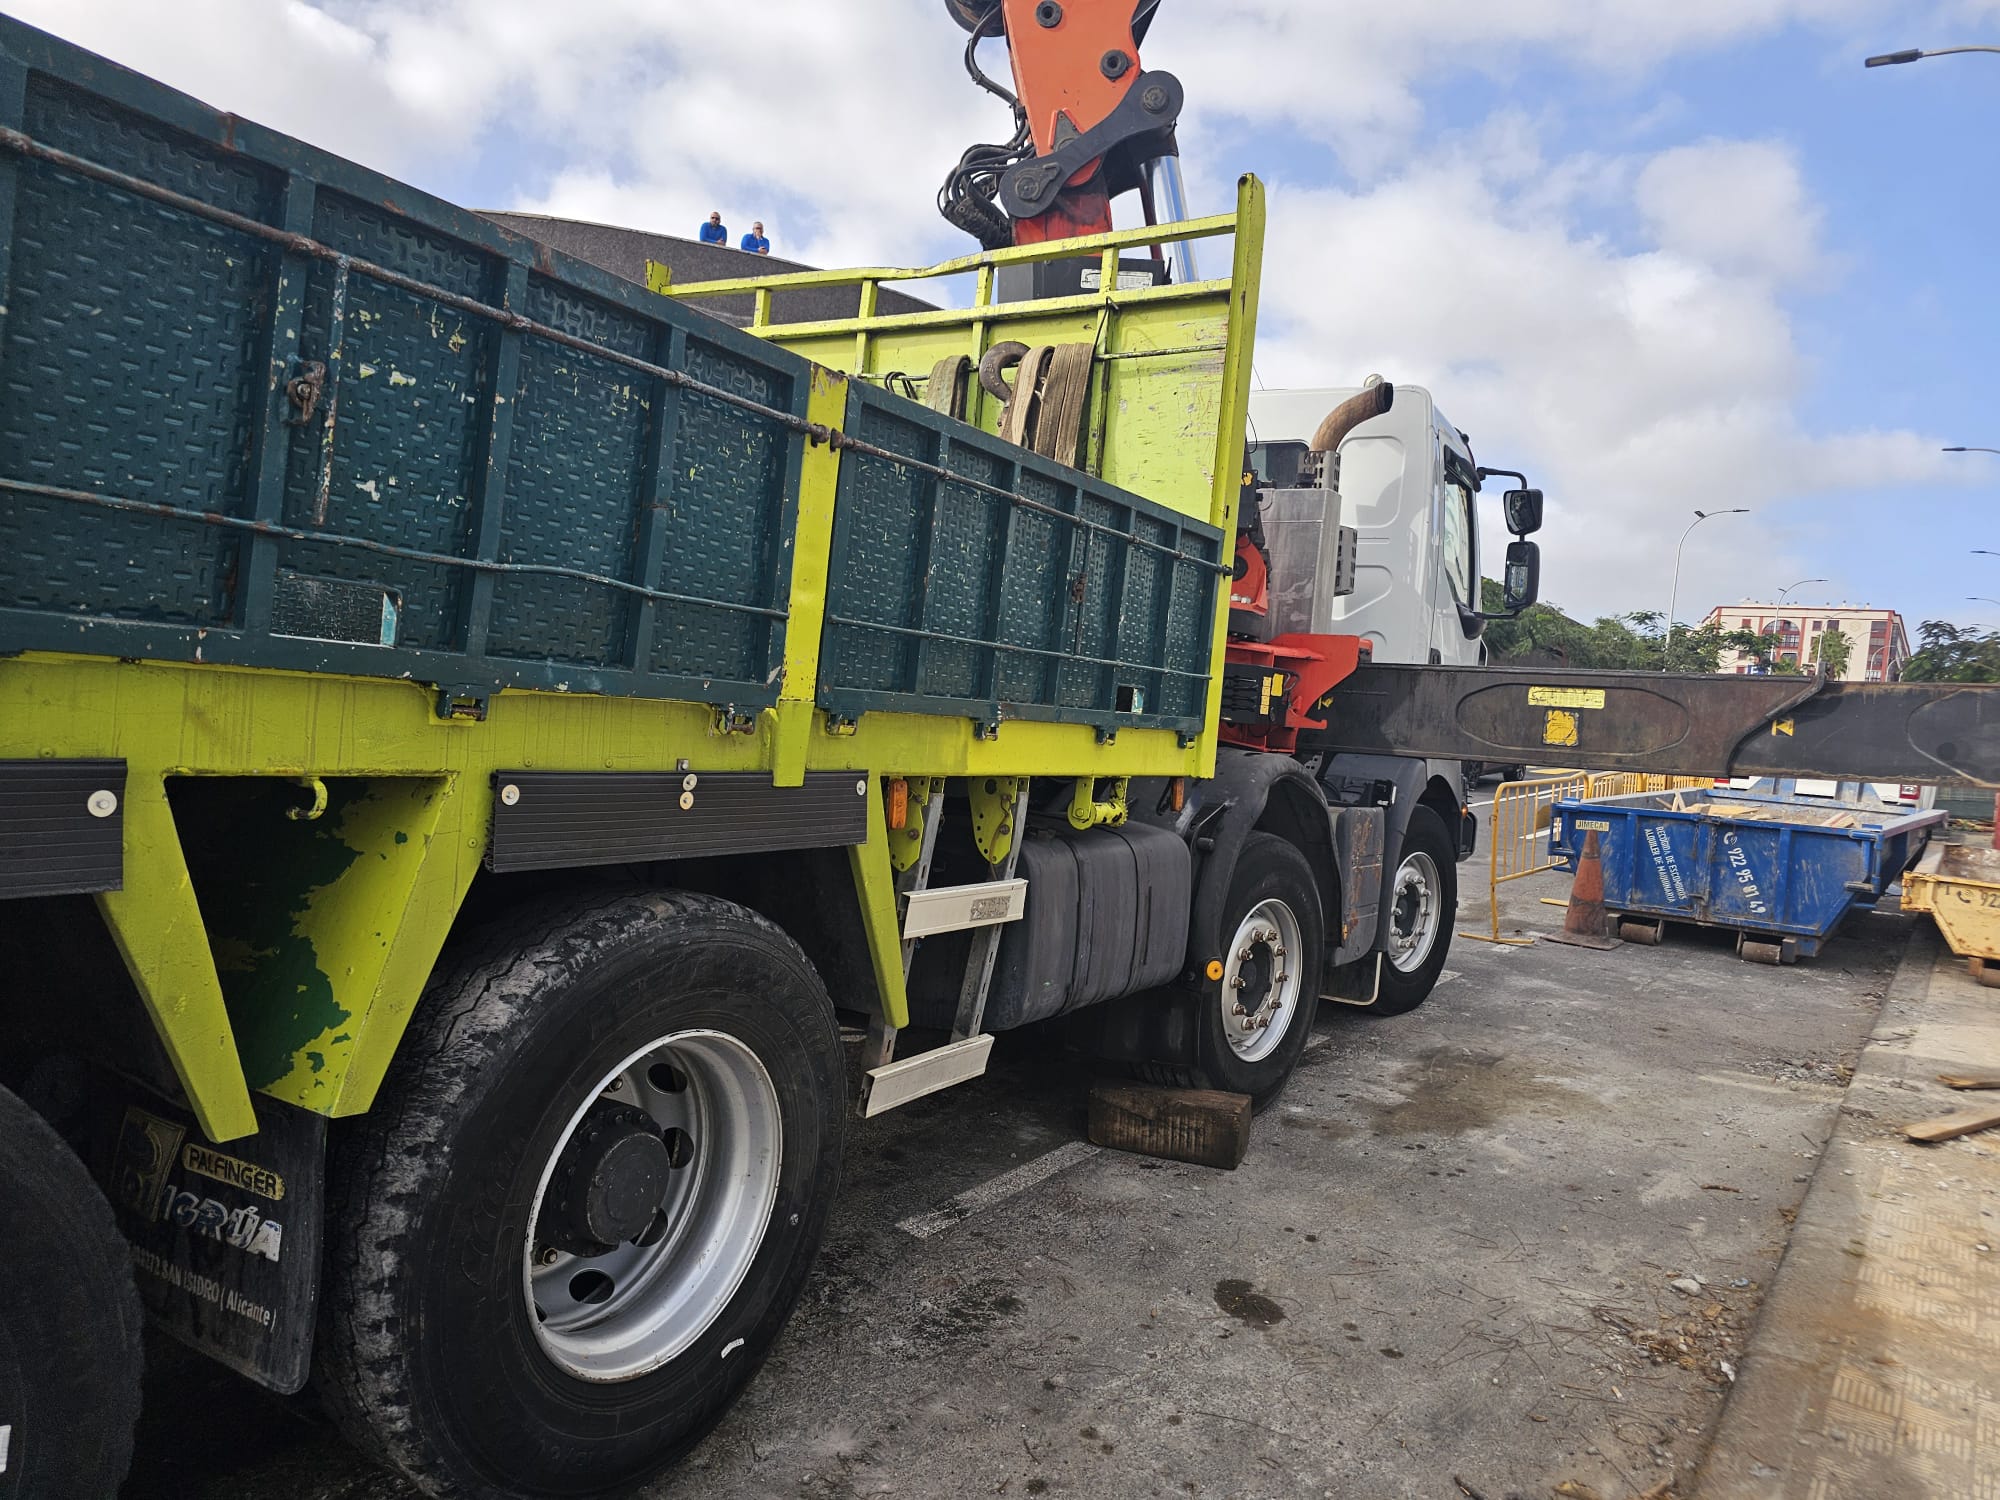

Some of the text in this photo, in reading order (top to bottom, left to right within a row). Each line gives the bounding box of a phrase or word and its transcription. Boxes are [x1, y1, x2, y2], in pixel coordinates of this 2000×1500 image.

[1577, 820, 1604, 829] JIMECA
[1644, 828, 1660, 856] ALQUILER
[1653, 856, 1664, 865] DE
[1665, 855, 1675, 864] DE
[1727, 847, 1747, 868] 922
[1668, 864, 1688, 900] ESCOMBROS
[1735, 868, 1754, 883] 95
[1749, 900, 1767, 914] 49
[189, 1148, 277, 1196] PALFINGER
[183, 1271, 219, 1301] ISIDRO
[226, 1289, 271, 1326] Alicante
